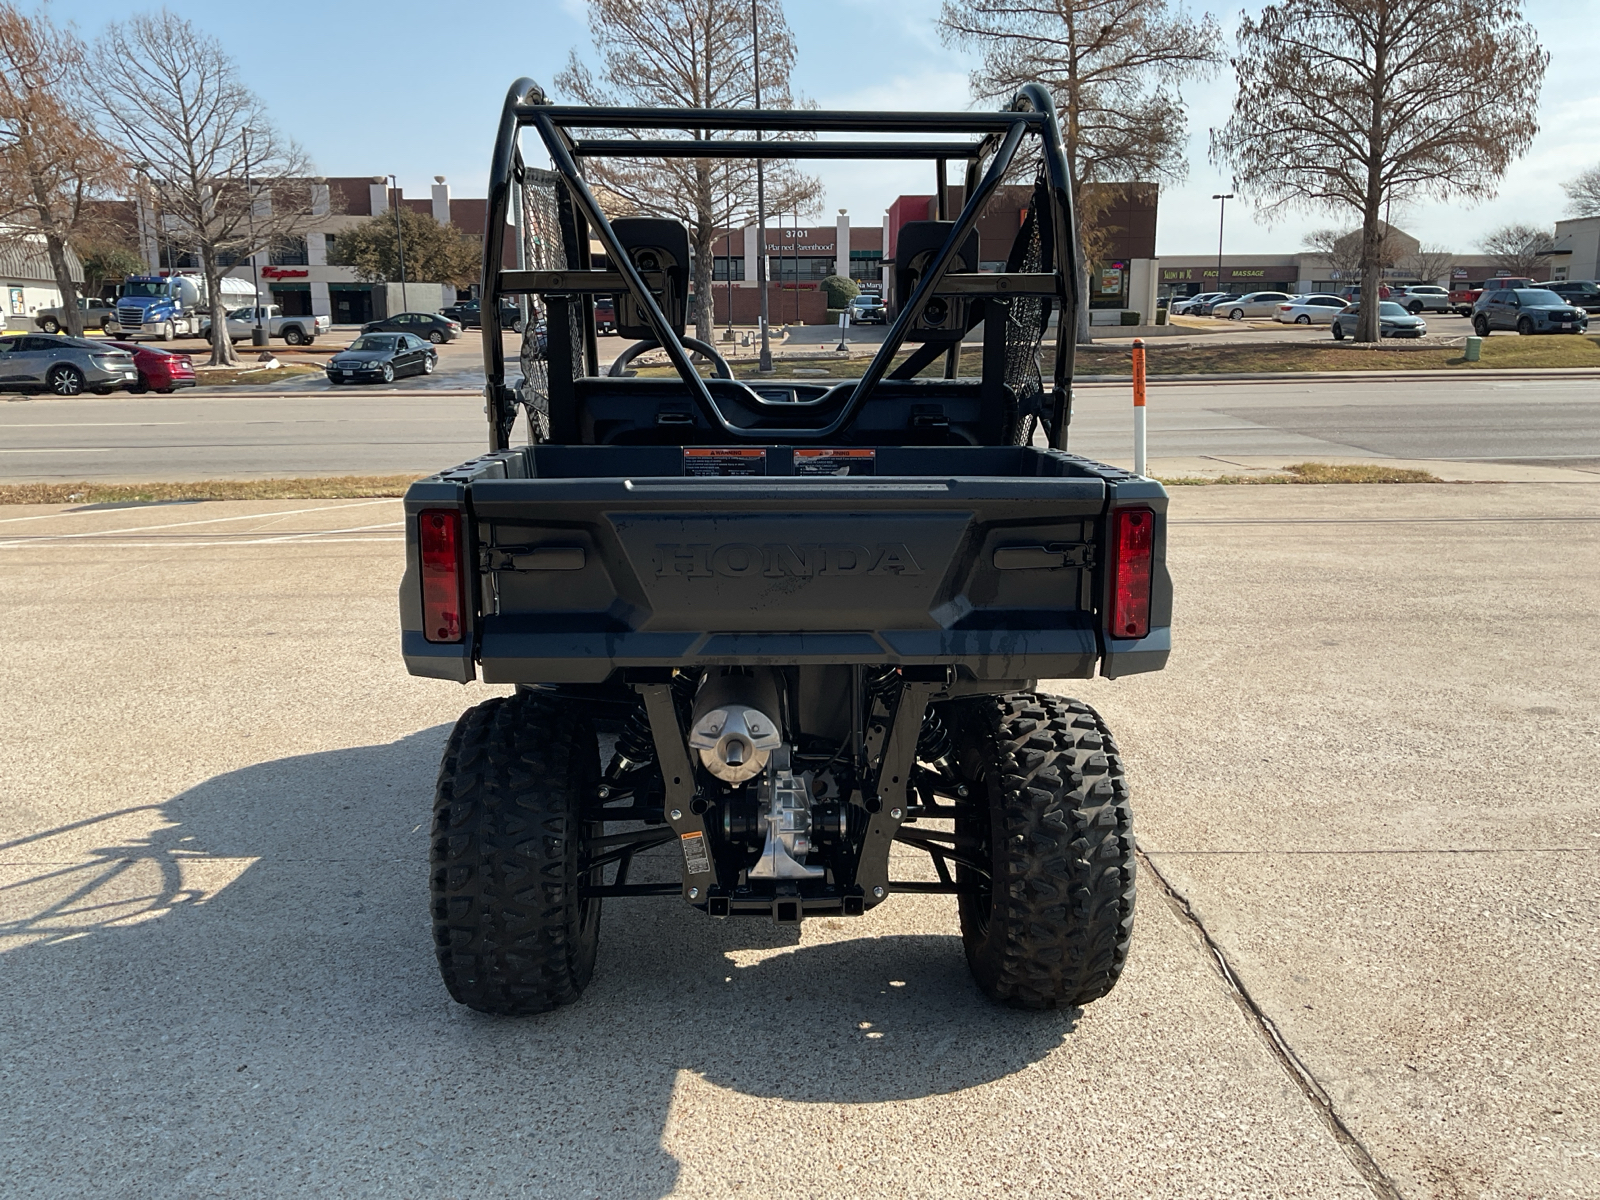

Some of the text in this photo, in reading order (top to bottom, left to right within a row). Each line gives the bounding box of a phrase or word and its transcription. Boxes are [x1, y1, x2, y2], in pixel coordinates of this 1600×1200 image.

[785, 230, 808, 238] 3701
[768, 243, 833, 251] Planned Parenthood
[1232, 270, 1265, 278] MASSAGE
[655, 542, 924, 579] HONDA
